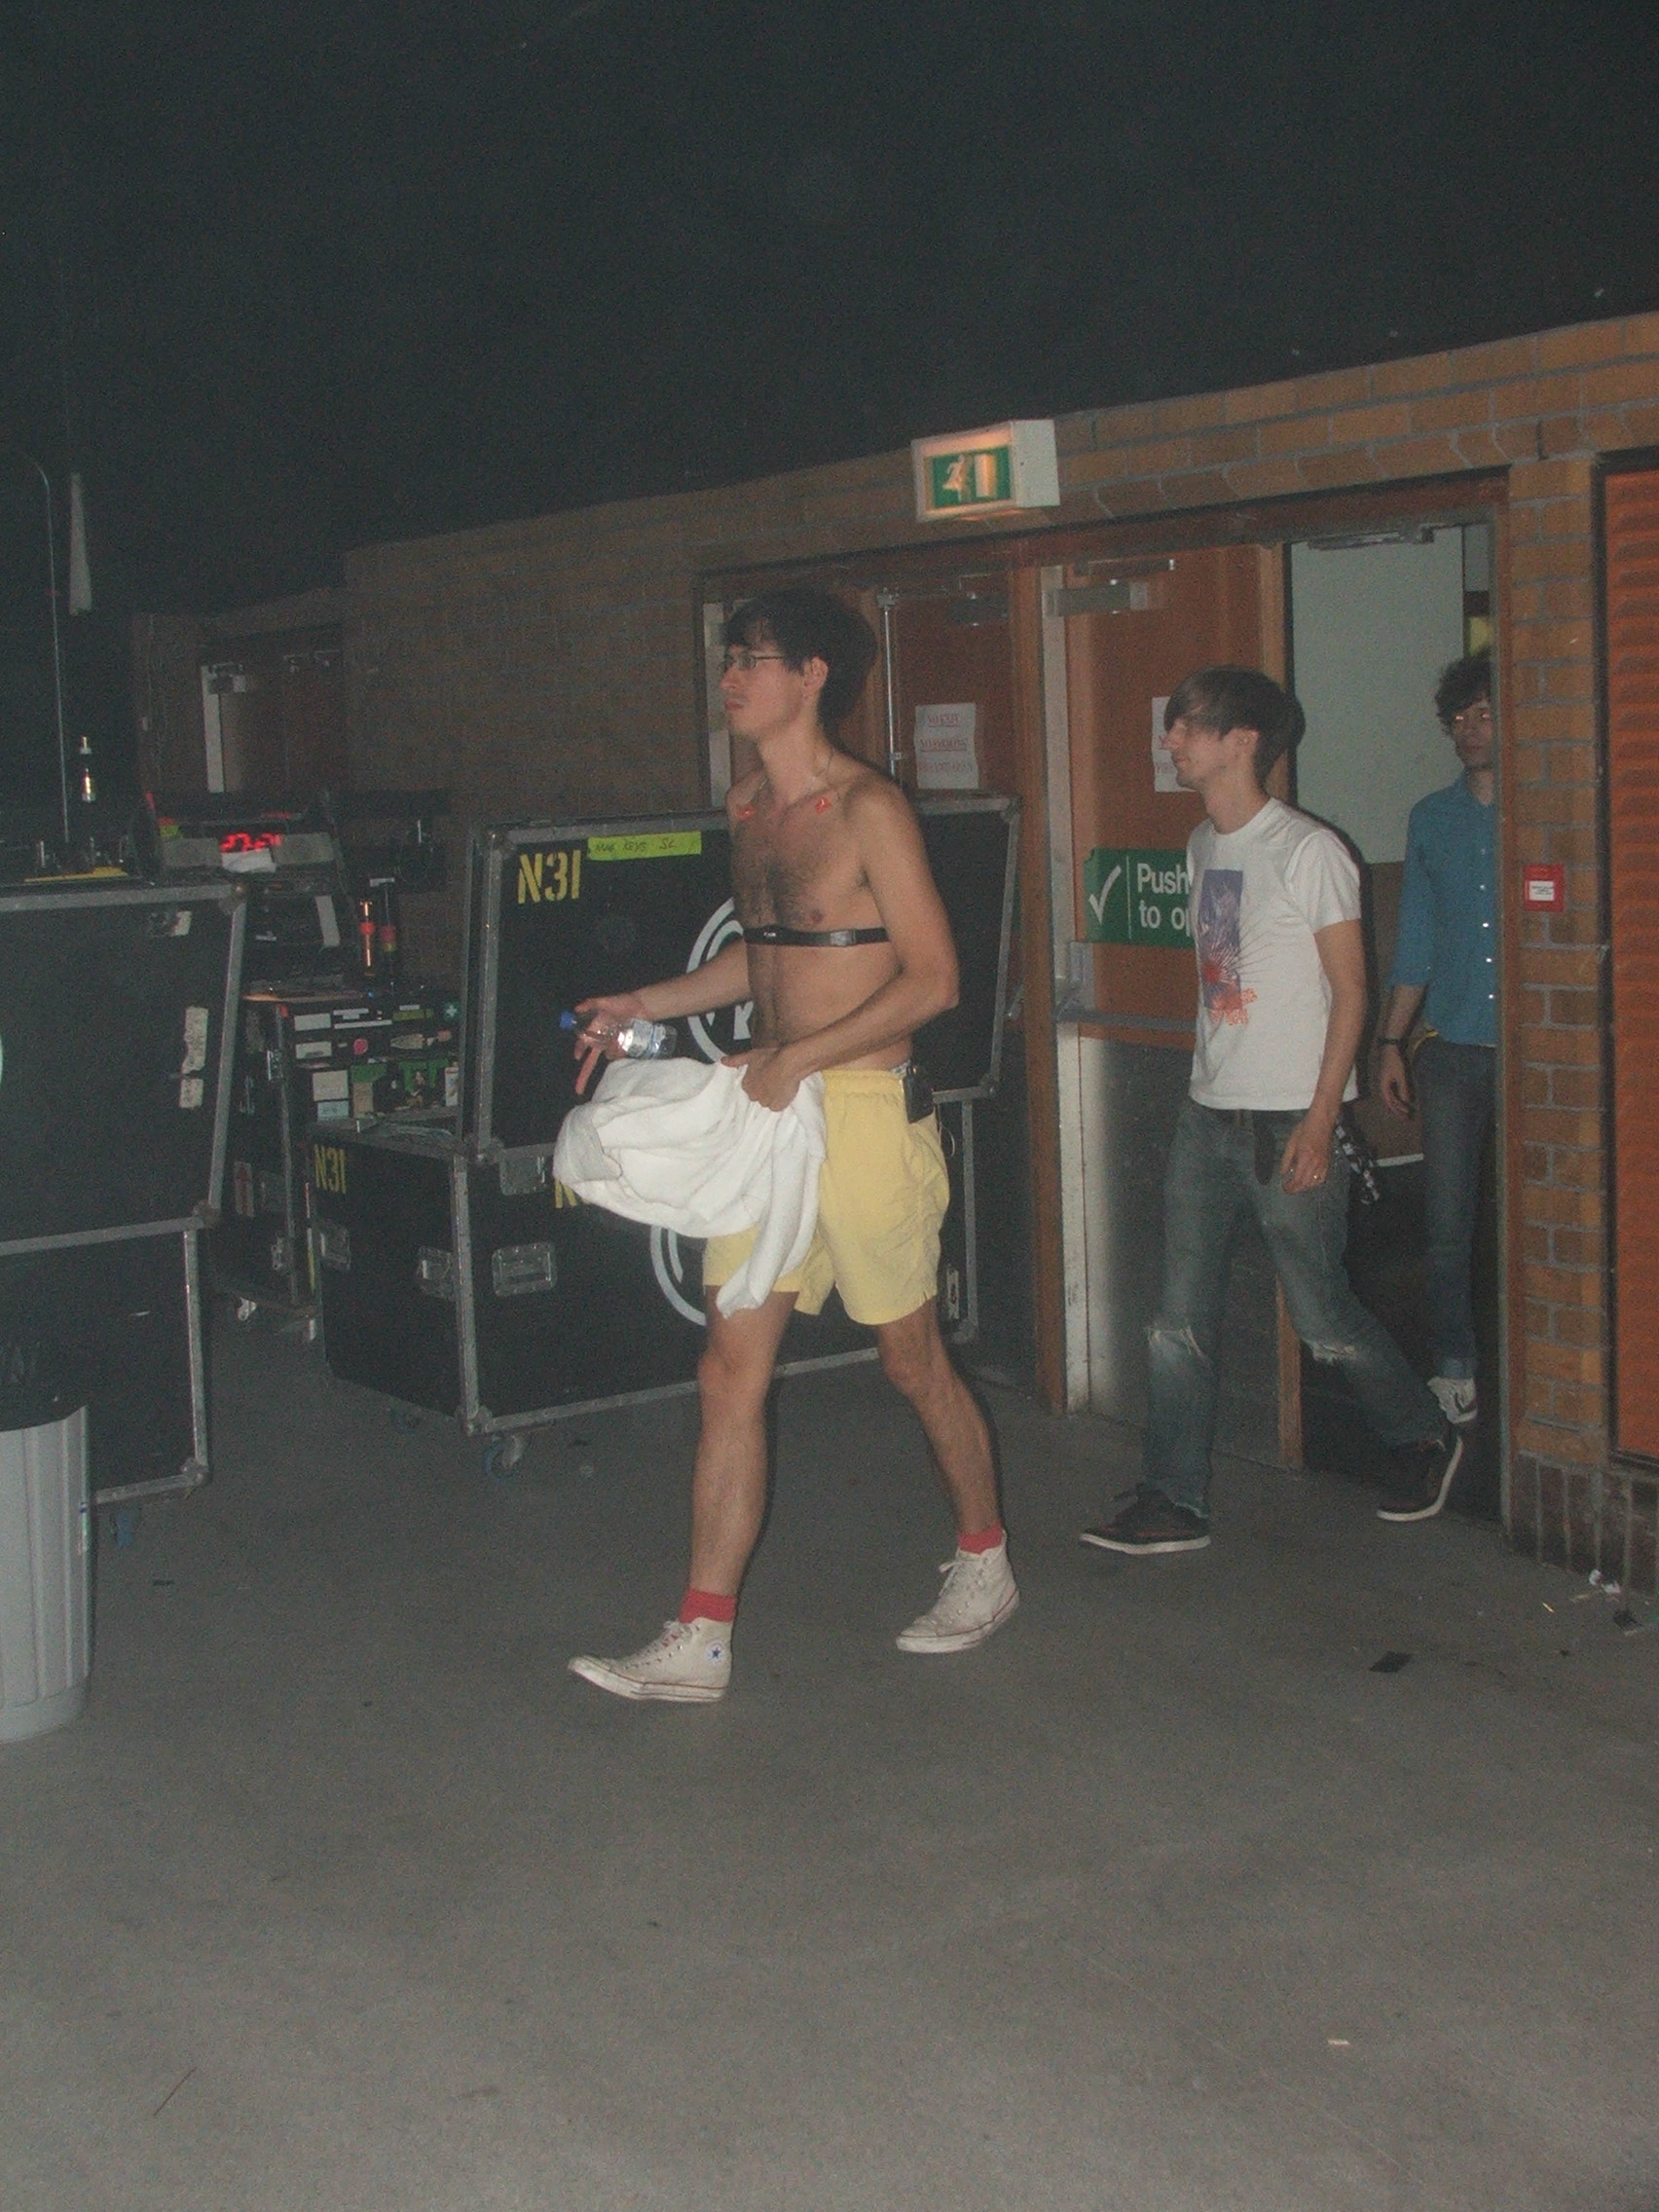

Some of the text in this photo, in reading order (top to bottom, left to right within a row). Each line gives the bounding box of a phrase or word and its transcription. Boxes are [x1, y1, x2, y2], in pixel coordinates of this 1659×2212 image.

[517, 849, 581, 904] N31
[1136, 863, 1190, 895] Push
[1138, 900, 1161, 929] to
[313, 1143, 347, 1195] N31
